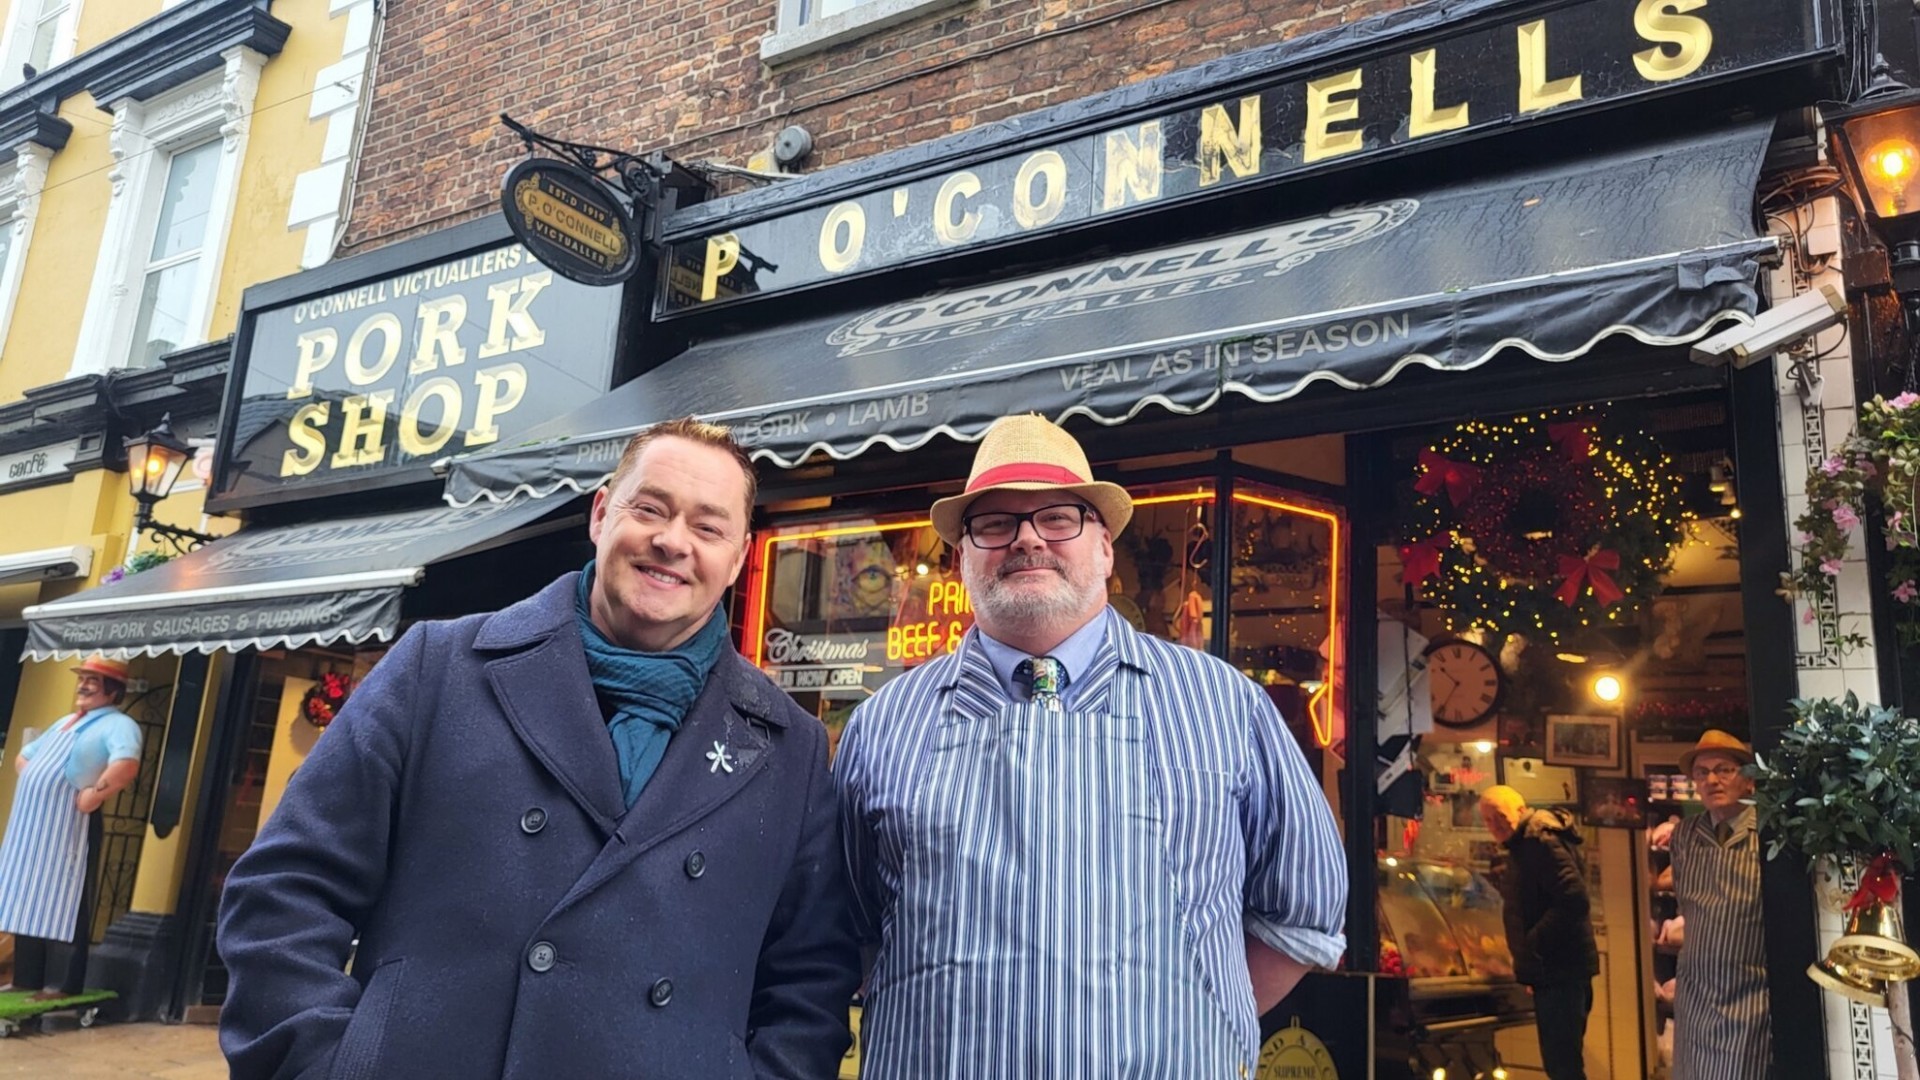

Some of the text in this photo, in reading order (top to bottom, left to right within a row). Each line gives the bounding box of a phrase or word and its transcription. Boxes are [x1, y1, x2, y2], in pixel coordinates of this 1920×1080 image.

[701, 0, 1714, 301] P O'CONNELLS
[542, 202, 617, 252] O'CONNELL
[583, 203, 605, 222] 1919
[535, 221, 605, 264] VICTUALLER
[293, 279, 388, 323] O'CONNELL
[393, 244, 522, 299] VICTUALLERS
[887, 272, 1242, 347] VICTUALLER
[288, 271, 553, 400] PORK
[1059, 313, 1410, 392] VEAL AS IN SEASON
[280, 362, 528, 478] SHOP
[848, 392, 929, 426] LAMB
[62, 604, 344, 642] FRESH PORK SAUSAGES & PUDDINGS
[765, 628, 869, 663] Christmas
[886, 620, 963, 661] BEEF &
[796, 670, 829, 688] NOW
[831, 668, 863, 685] OPEN
